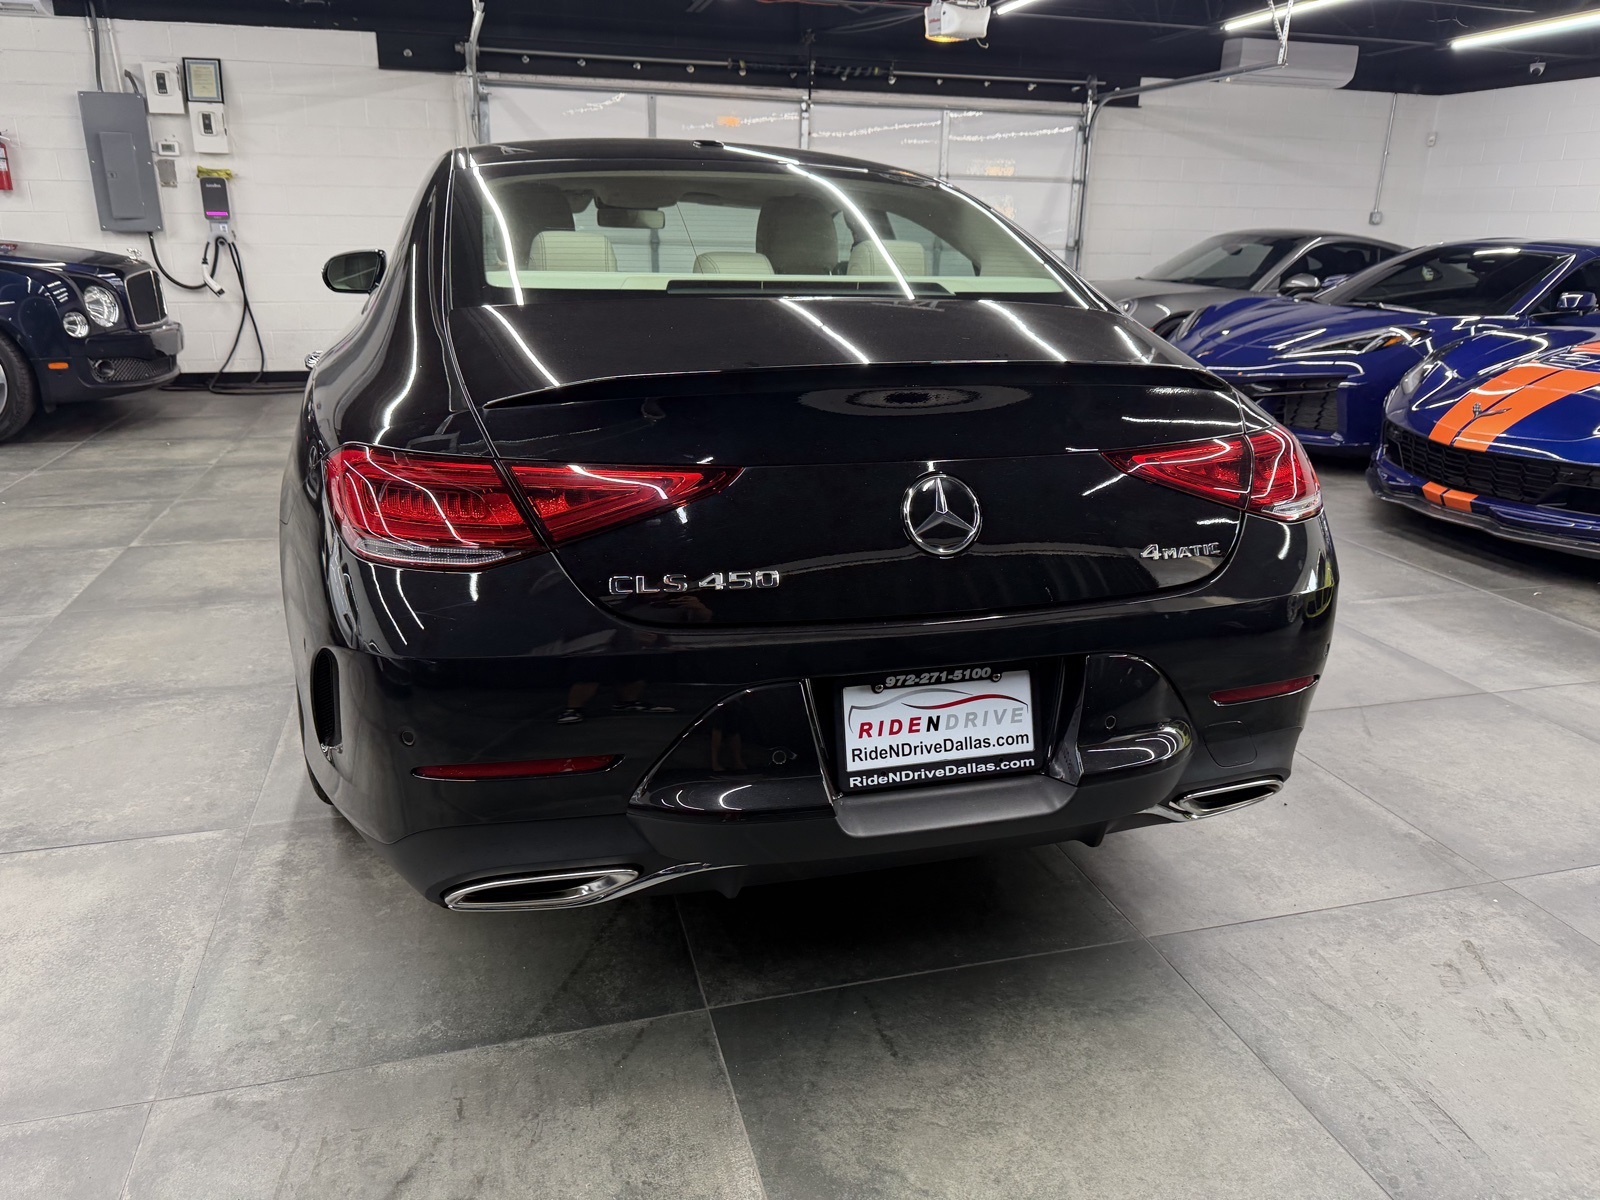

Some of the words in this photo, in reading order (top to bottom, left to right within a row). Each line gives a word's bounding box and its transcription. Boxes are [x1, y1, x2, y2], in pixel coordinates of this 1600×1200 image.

[1140, 542, 1221, 560] 4MATIC
[608, 574, 688, 595] CLS
[698, 570, 780, 591] 450
[885, 667, 992, 688] 972-271-5100
[851, 733, 1030, 763] RideNDriveDallas.com
[849, 757, 1035, 788] RideNDriveDallas.com
